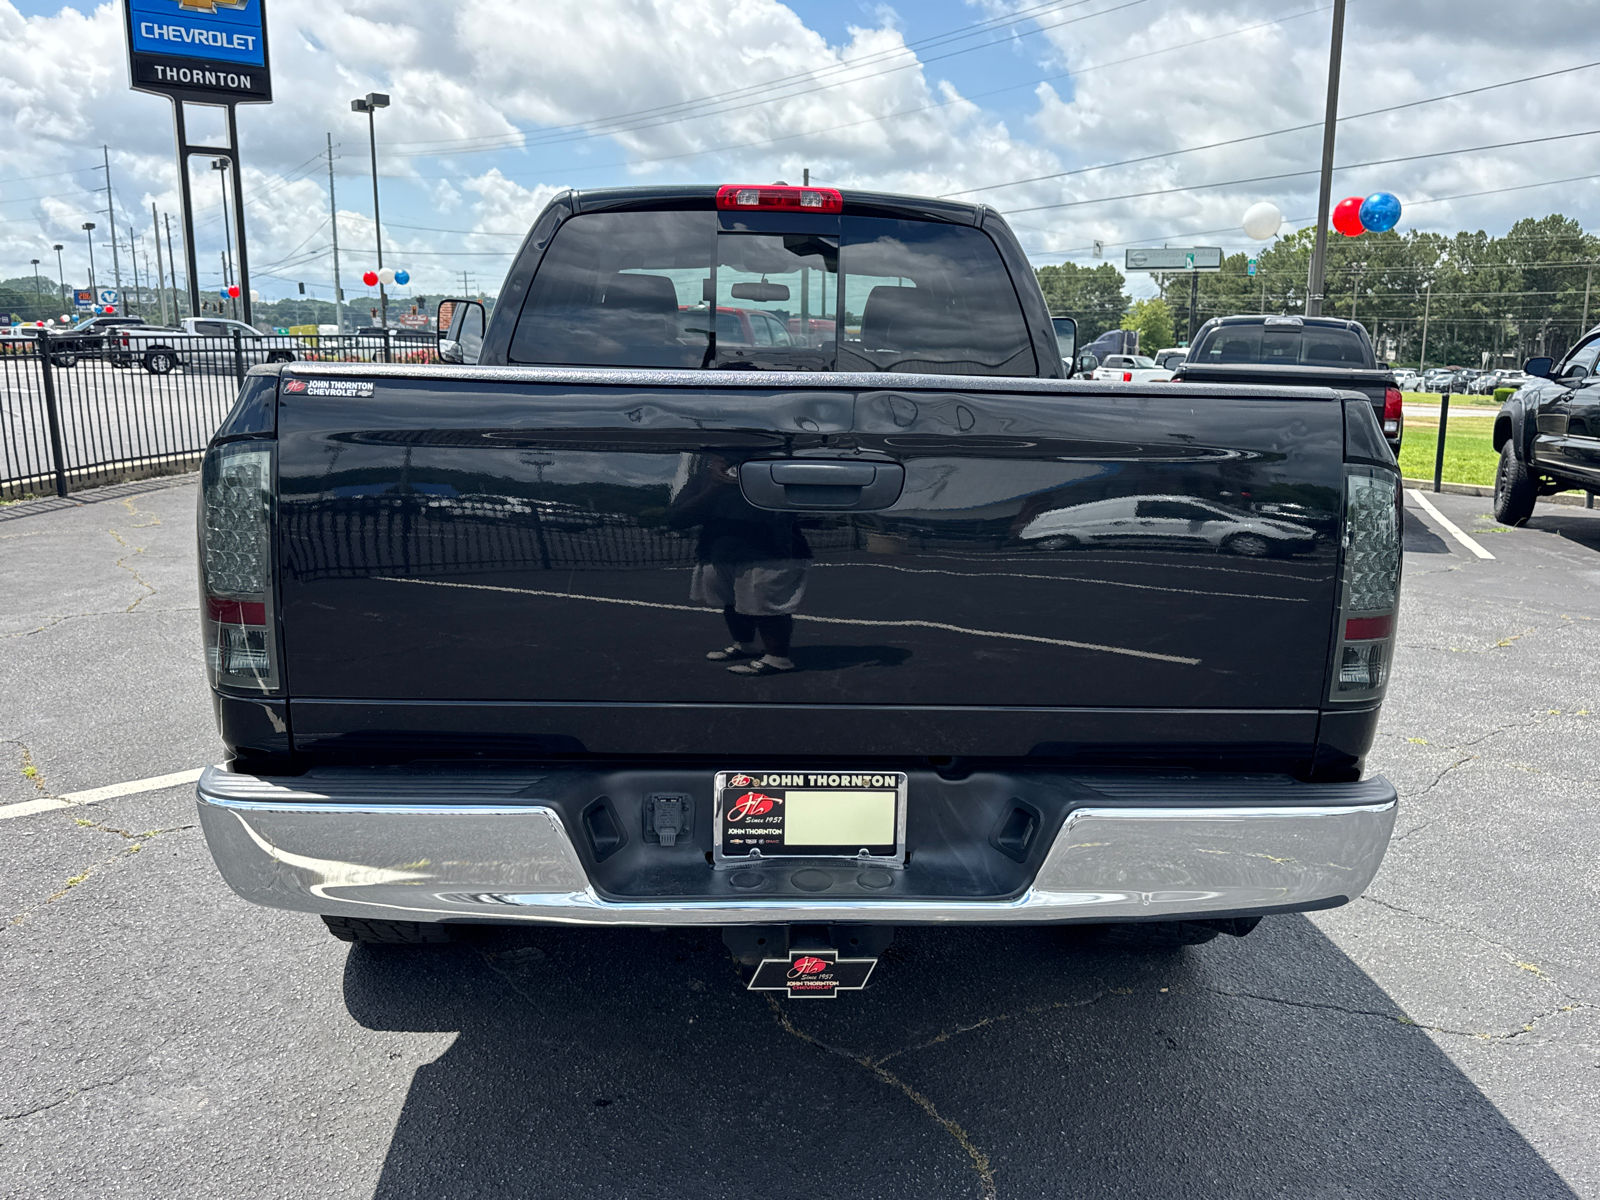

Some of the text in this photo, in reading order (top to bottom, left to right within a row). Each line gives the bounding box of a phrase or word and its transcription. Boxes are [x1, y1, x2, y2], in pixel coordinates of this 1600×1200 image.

[140, 22, 256, 51] CHEVROLET
[154, 65, 251, 89] THORNTON
[308, 380, 329, 388] JOHN
[330, 381, 373, 390] THORNTON
[307, 388, 357, 396] CHEVROLET
[761, 775, 804, 787] JOHN
[808, 775, 896, 787] THORNTON
[745, 816, 783, 824] Since 1957
